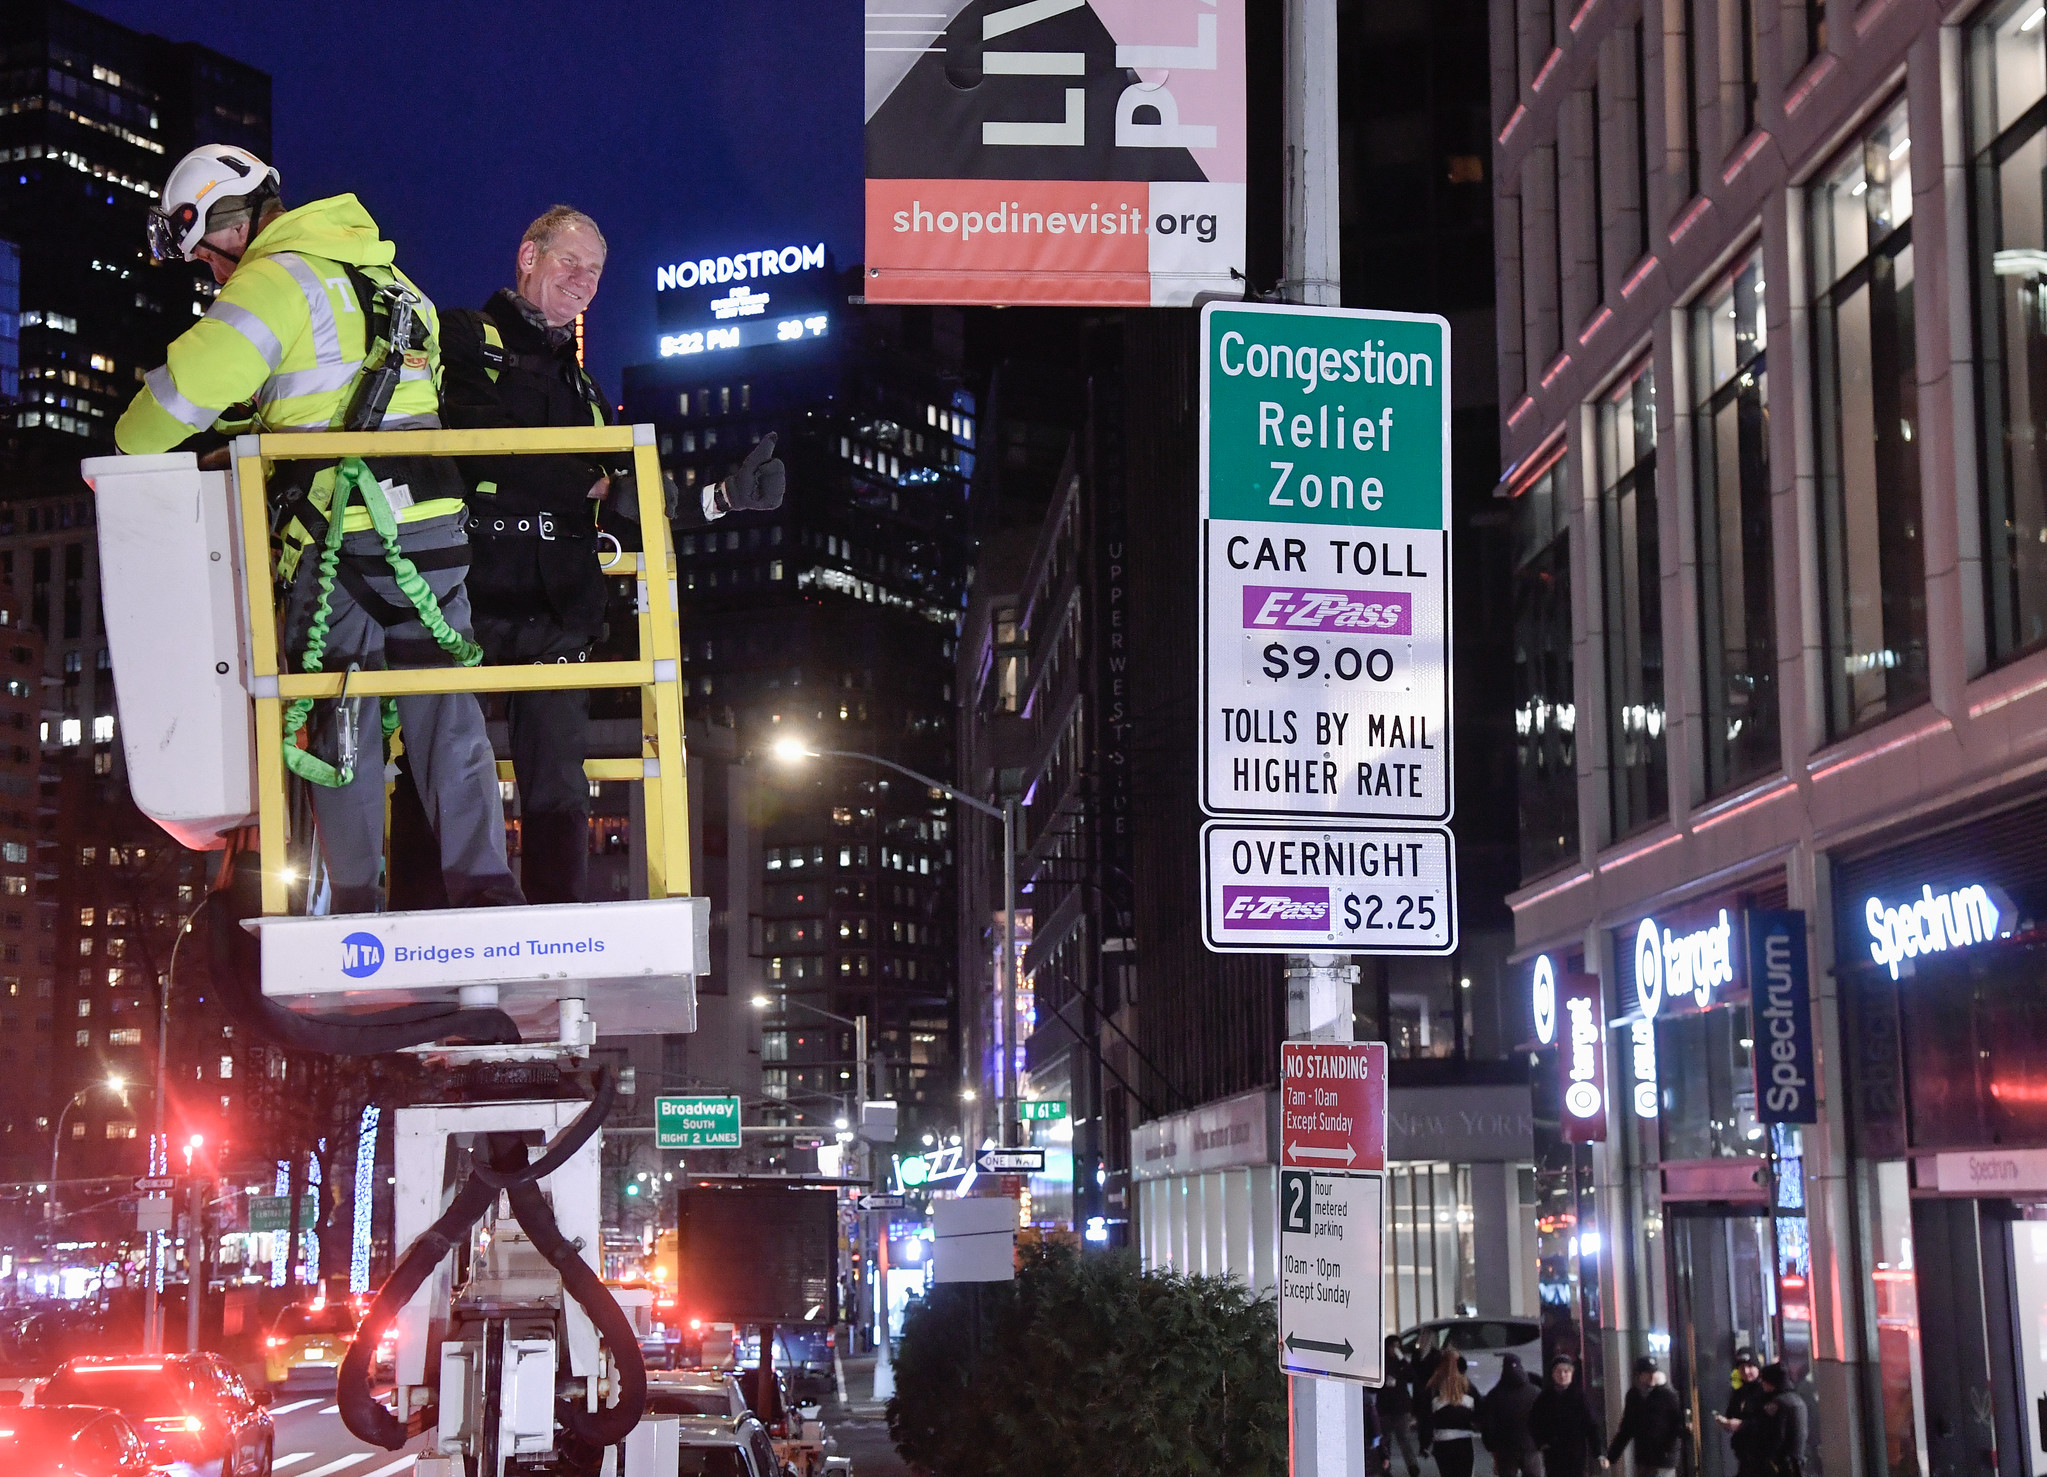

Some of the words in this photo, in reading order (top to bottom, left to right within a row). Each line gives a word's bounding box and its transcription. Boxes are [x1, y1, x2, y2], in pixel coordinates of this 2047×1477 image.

[1115, 0, 1218, 148] PL
[893, 201, 1217, 243] shopdinevisit.org
[657, 243, 825, 291] NORDSTROM
[1219, 331, 1433, 394] Congestion
[1259, 401, 1393, 452] Relief
[1269, 462, 1384, 511] Zone
[1227, 536, 1307, 572] CAR
[1330, 541, 1427, 577] TOLL
[1253, 592, 1402, 628] E-ZPass
[1262, 642, 1394, 682] $9.00
[1222, 708, 1298, 744] TOLLS
[1316, 712, 1349, 746] BY
[1369, 714, 1434, 750] MAIL
[1234, 757, 1338, 794] HIGHER
[1358, 762, 1423, 798] RATE
[1232, 840, 1423, 877] OVERNIGHT
[1224, 895, 1329, 921] E-ZPass
[1344, 892, 1436, 933] $2.25
[1865, 884, 1994, 981] Spectrum
[341, 942, 381, 970] MTA
[395, 945, 475, 963] Bridges
[483, 942, 520, 958] and
[526, 938, 605, 956] Tunnels
[1663, 908, 1733, 1007] target
[1766, 935, 1806, 1112] Spectrum
[1287, 1055, 1304, 1078] NO
[1307, 1055, 1368, 1080] STANDING
[661, 1102, 734, 1118] Broadway
[1025, 1104, 1035, 1118] W
[1038, 1103, 1049, 1118] 61
[1287, 1087, 1306, 1106] 7am
[1314, 1088, 1338, 1106] 10am
[661, 1133, 688, 1143] RIGHT
[692, 1133, 700, 1143] 2
[706, 1133, 737, 1143] LANES
[683, 1119, 715, 1129] SOUTH
[1287, 1111, 1317, 1134] Except
[1319, 1112, 1353, 1136] Sunday
[891, 1146, 967, 1196] jazz
[985, 1157, 1006, 1166] ONE
[1969, 1156, 2014, 1190] Spectrum
[1288, 1177, 1304, 1228] 2
[1315, 1180, 1332, 1196] hour
[1315, 1200, 1348, 1216] metered
[1315, 1220, 1343, 1240] parking
[1284, 1255, 1307, 1274] 10am
[1316, 1258, 1341, 1280] 10pm
[1284, 1280, 1314, 1303] Except
[1317, 1282, 1351, 1308] Sunday
